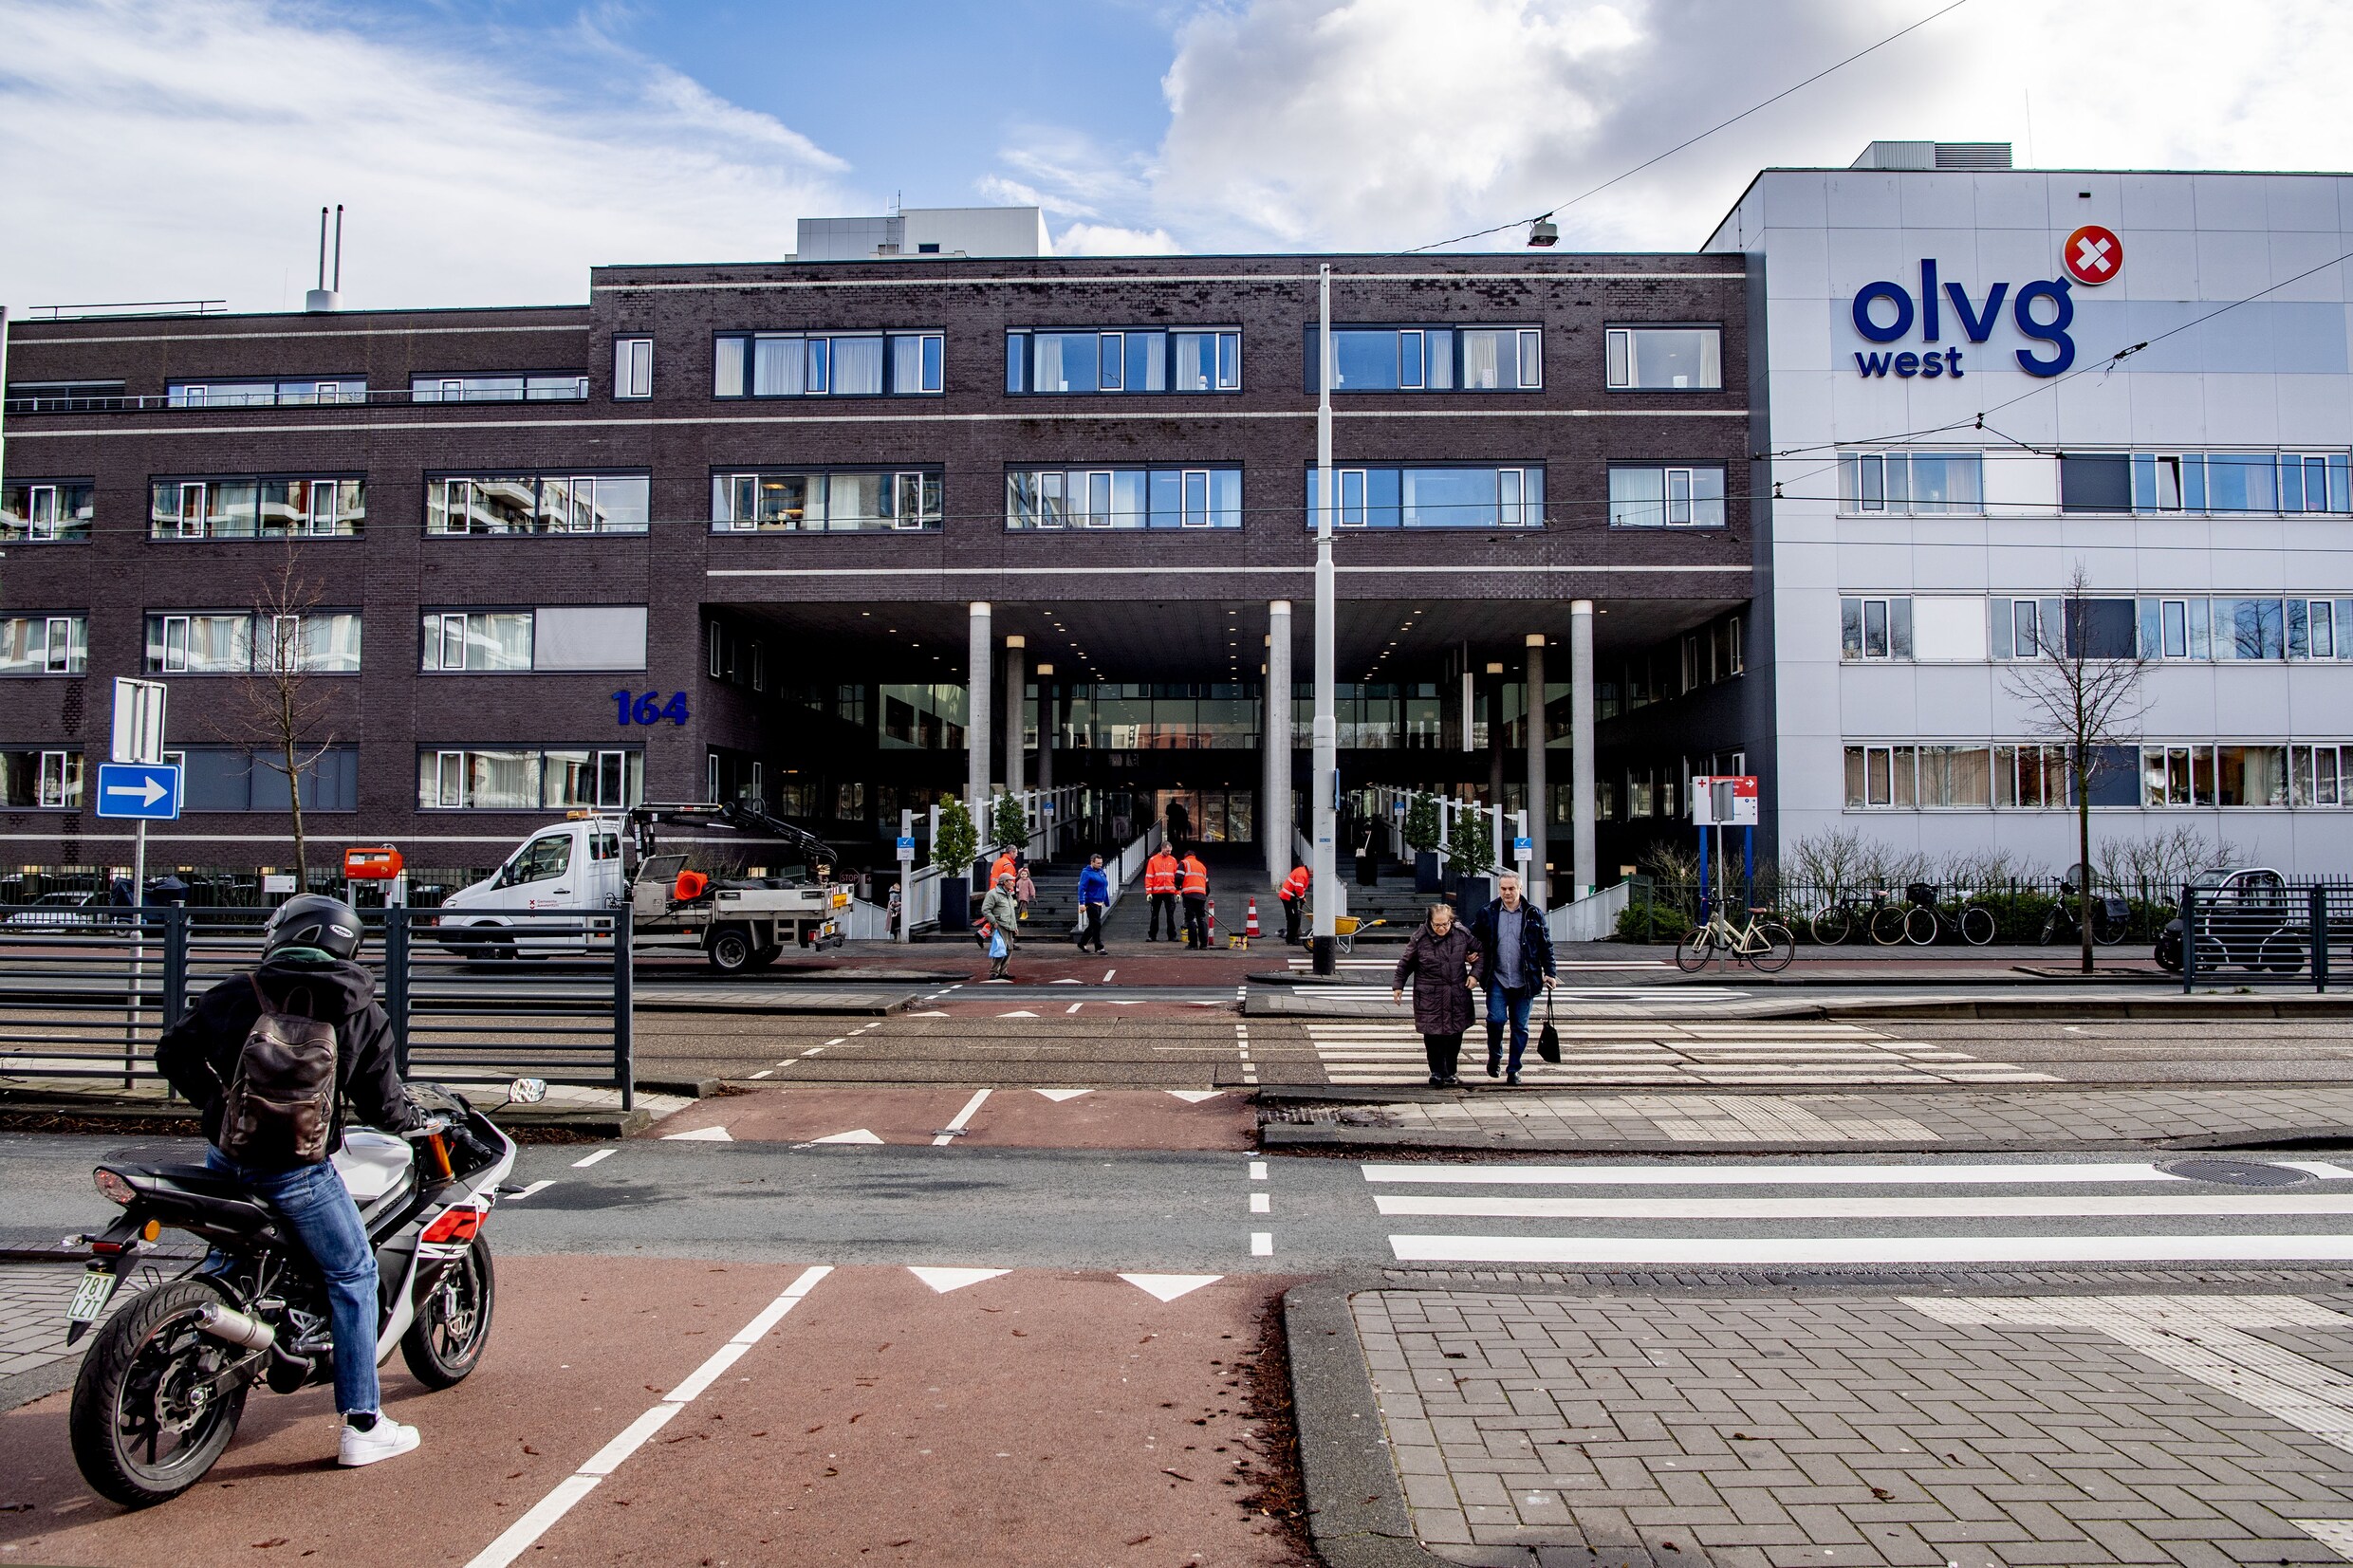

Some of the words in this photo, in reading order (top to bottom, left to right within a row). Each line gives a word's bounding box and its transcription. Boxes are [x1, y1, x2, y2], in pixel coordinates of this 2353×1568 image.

[1851, 258, 2076, 378] olvg
[1853, 346, 1965, 378] west
[612, 690, 690, 726] 164
[841, 874, 859, 882] STOP
[79, 1275, 109, 1297] 781
[69, 1298, 101, 1319] LZT
